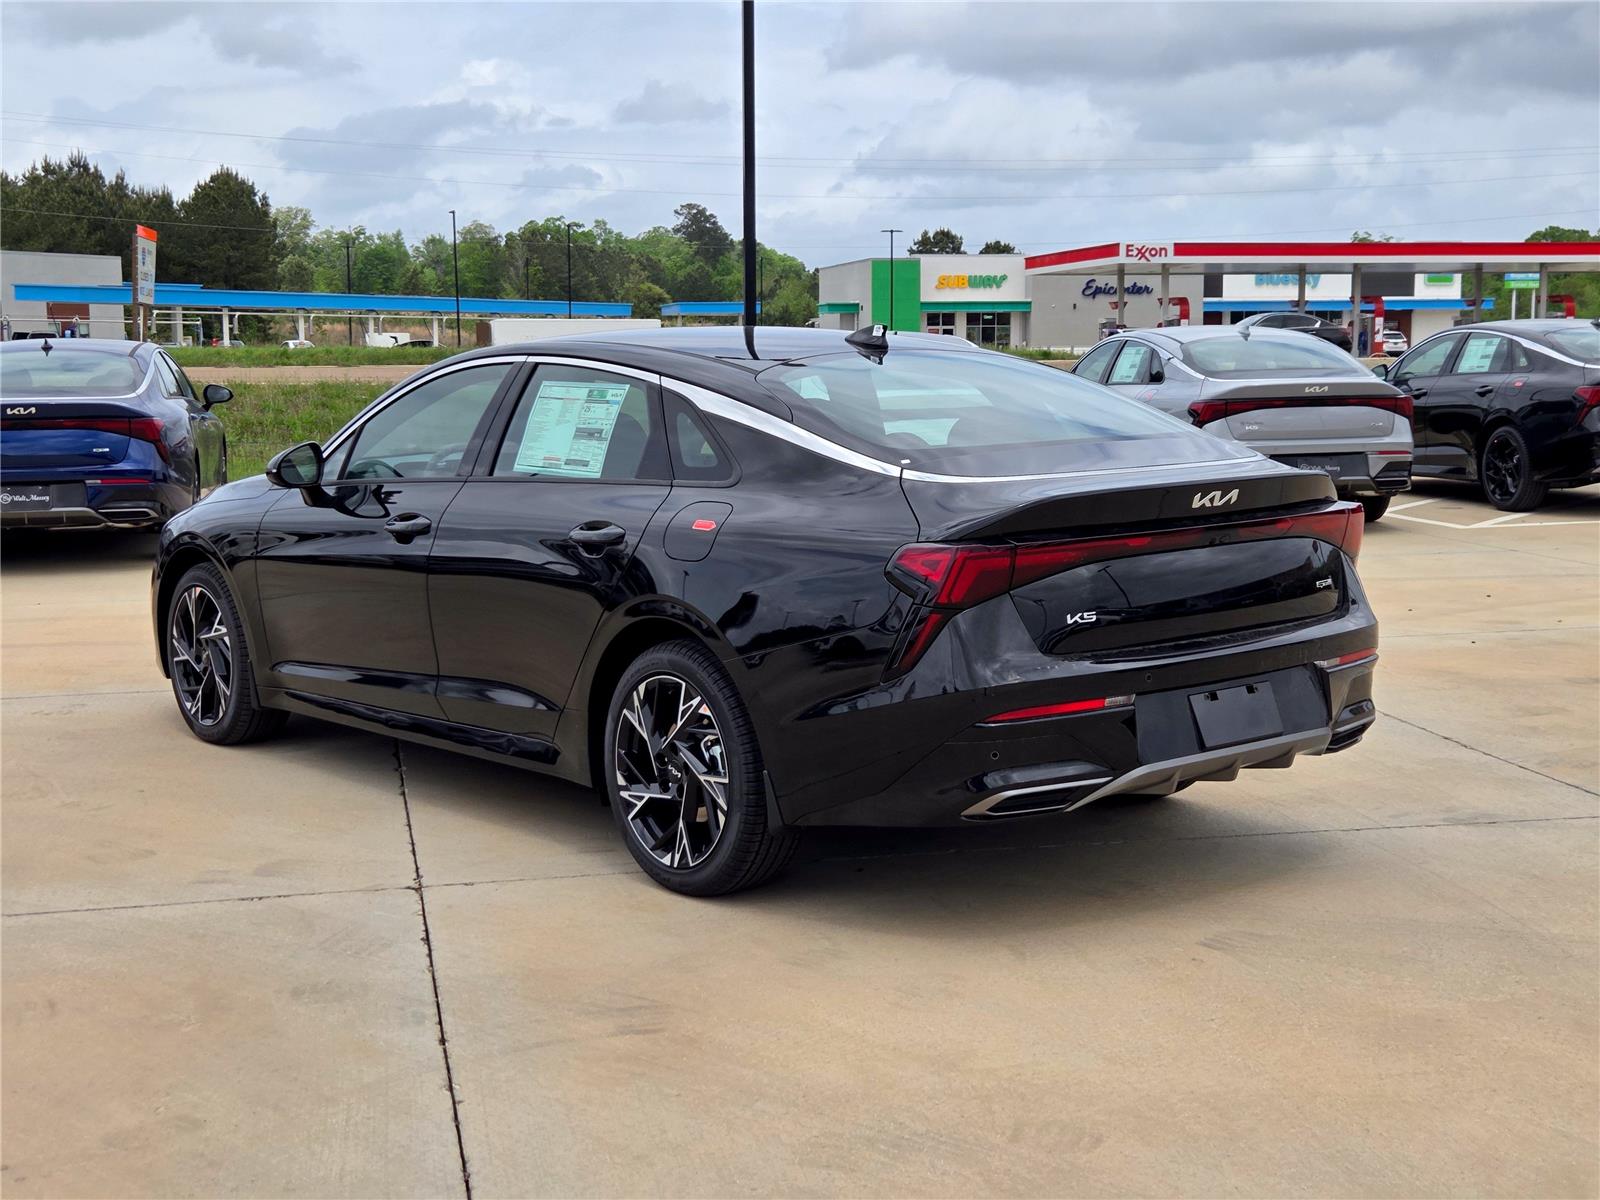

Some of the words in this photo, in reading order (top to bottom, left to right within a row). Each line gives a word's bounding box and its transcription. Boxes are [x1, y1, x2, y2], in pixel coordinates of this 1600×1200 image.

[1126, 244, 1168, 262] Exxon
[935, 274, 1008, 289] SUBWAY
[1082, 278, 1153, 299] Epicnter
[6, 407, 36, 415] KIA
[1191, 489, 1239, 508] KIA
[1066, 611, 1097, 624] K5
